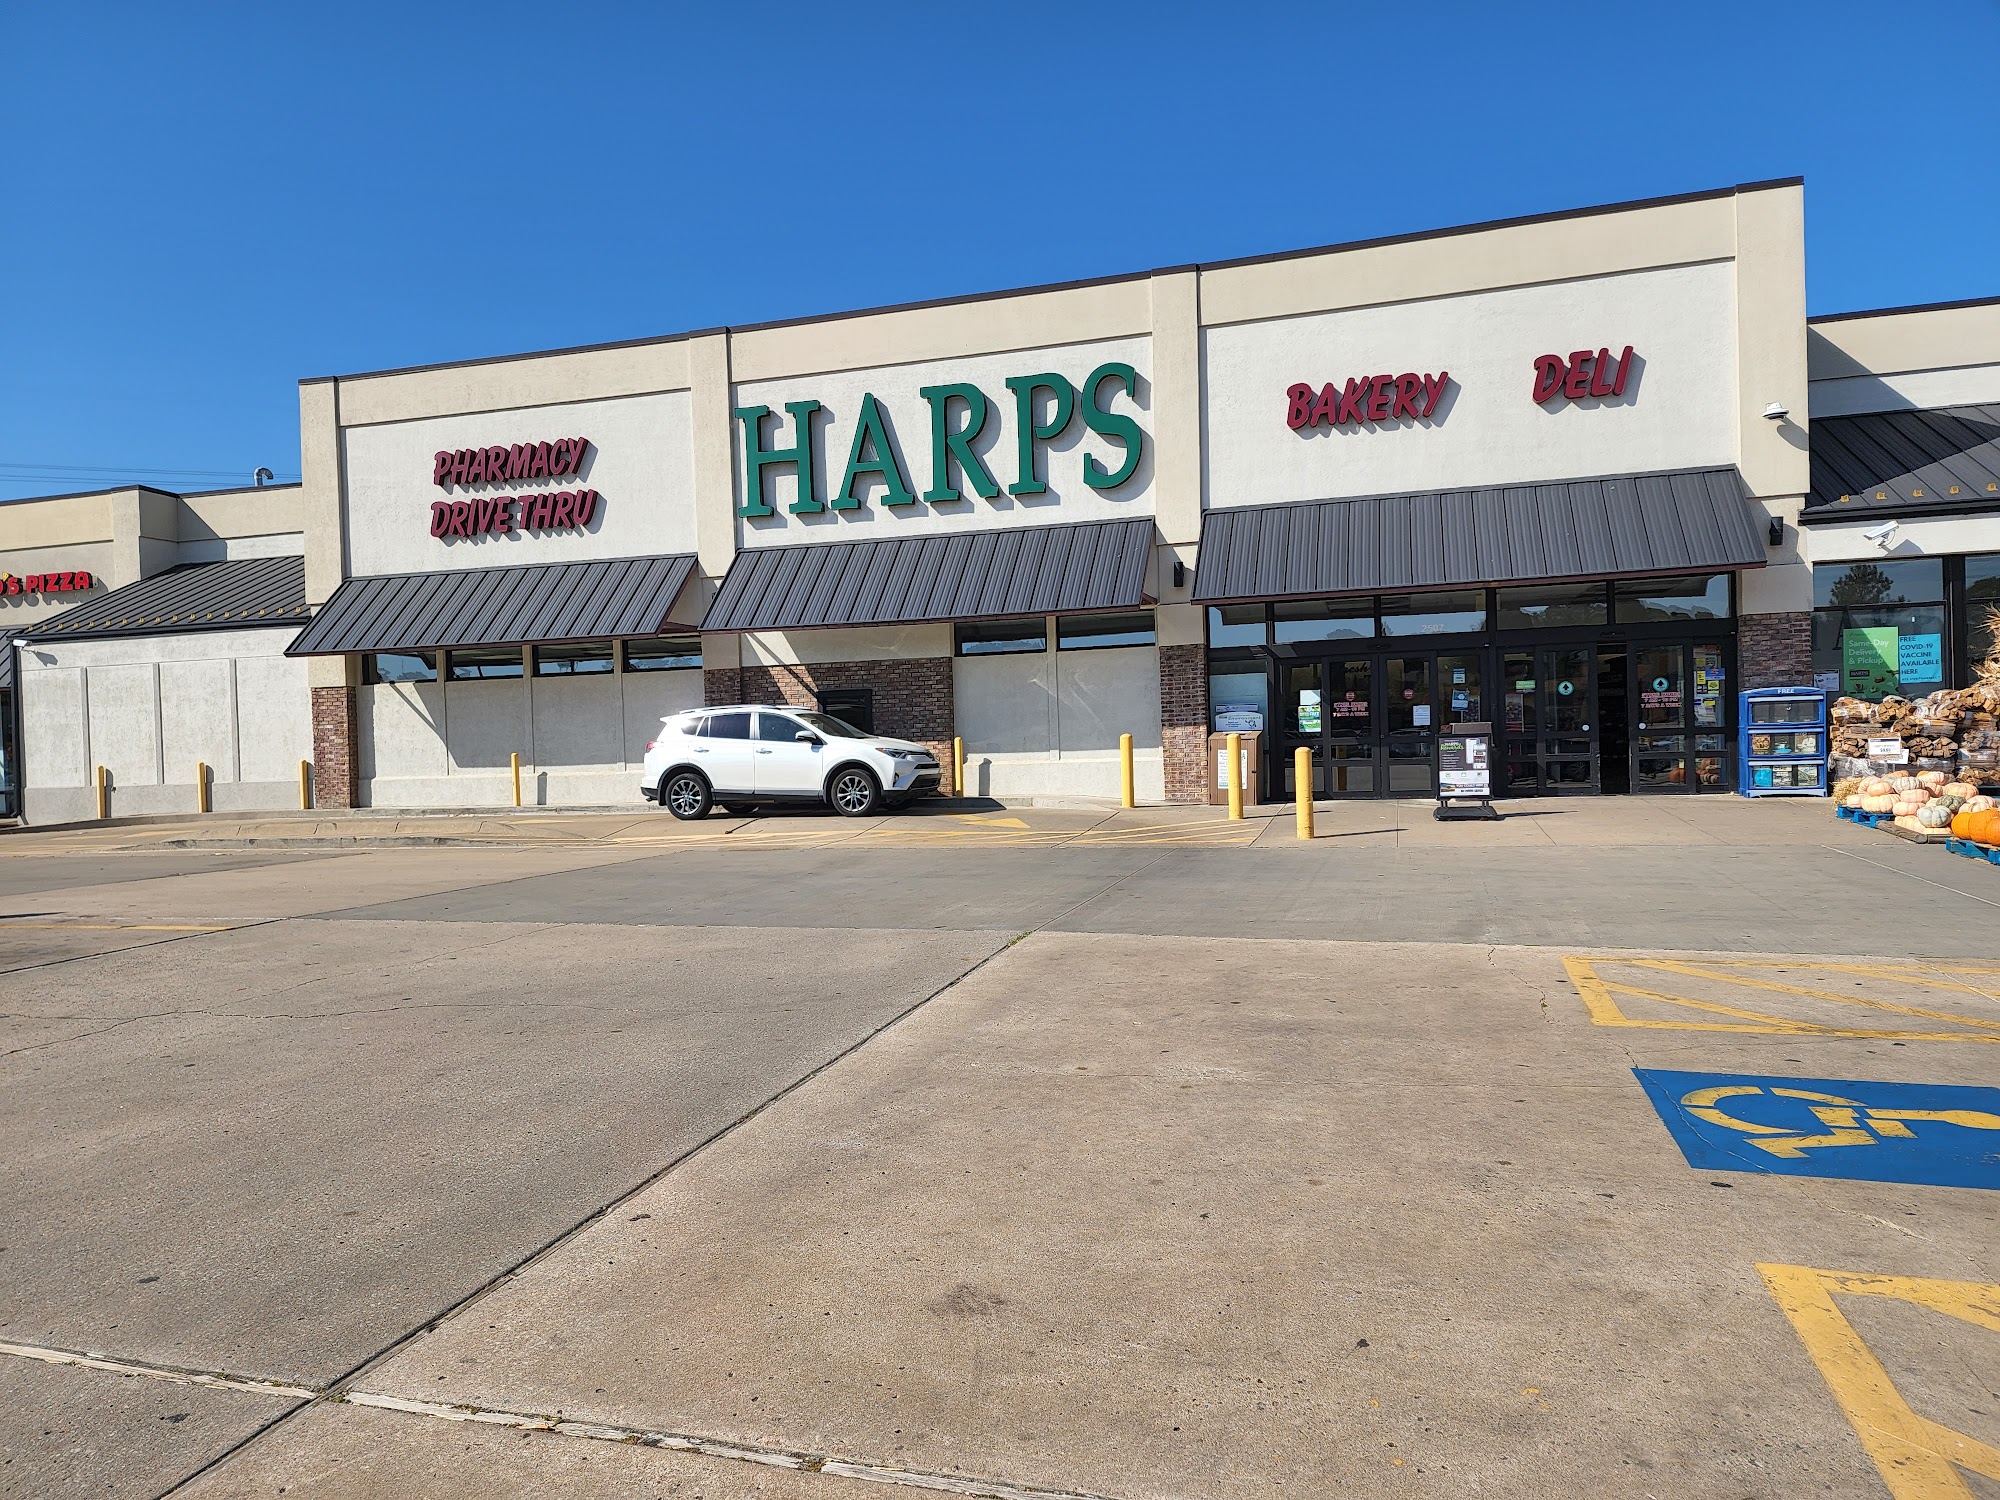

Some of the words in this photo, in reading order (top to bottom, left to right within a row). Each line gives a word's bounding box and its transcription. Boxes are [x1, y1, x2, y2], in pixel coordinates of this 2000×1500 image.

[1532, 346, 1633, 403] DELI
[1287, 372, 1449, 429] BAKERY
[735, 362, 1142, 517] HARPS
[434, 437, 588, 486] PHARMACY
[431, 496, 515, 538] DRIVE
[518, 489, 598, 530] THRU
[26, 571, 93, 593] PIZZA
[1421, 623, 1445, 633] 2507
[1848, 639, 1890, 648] Same-Day
[1900, 643, 1934, 651] COVID-19
[1848, 648, 1882, 657] Delivery
[1857, 657, 1884, 665] Pickup
[1900, 659, 1940, 667] AVAILABLE
